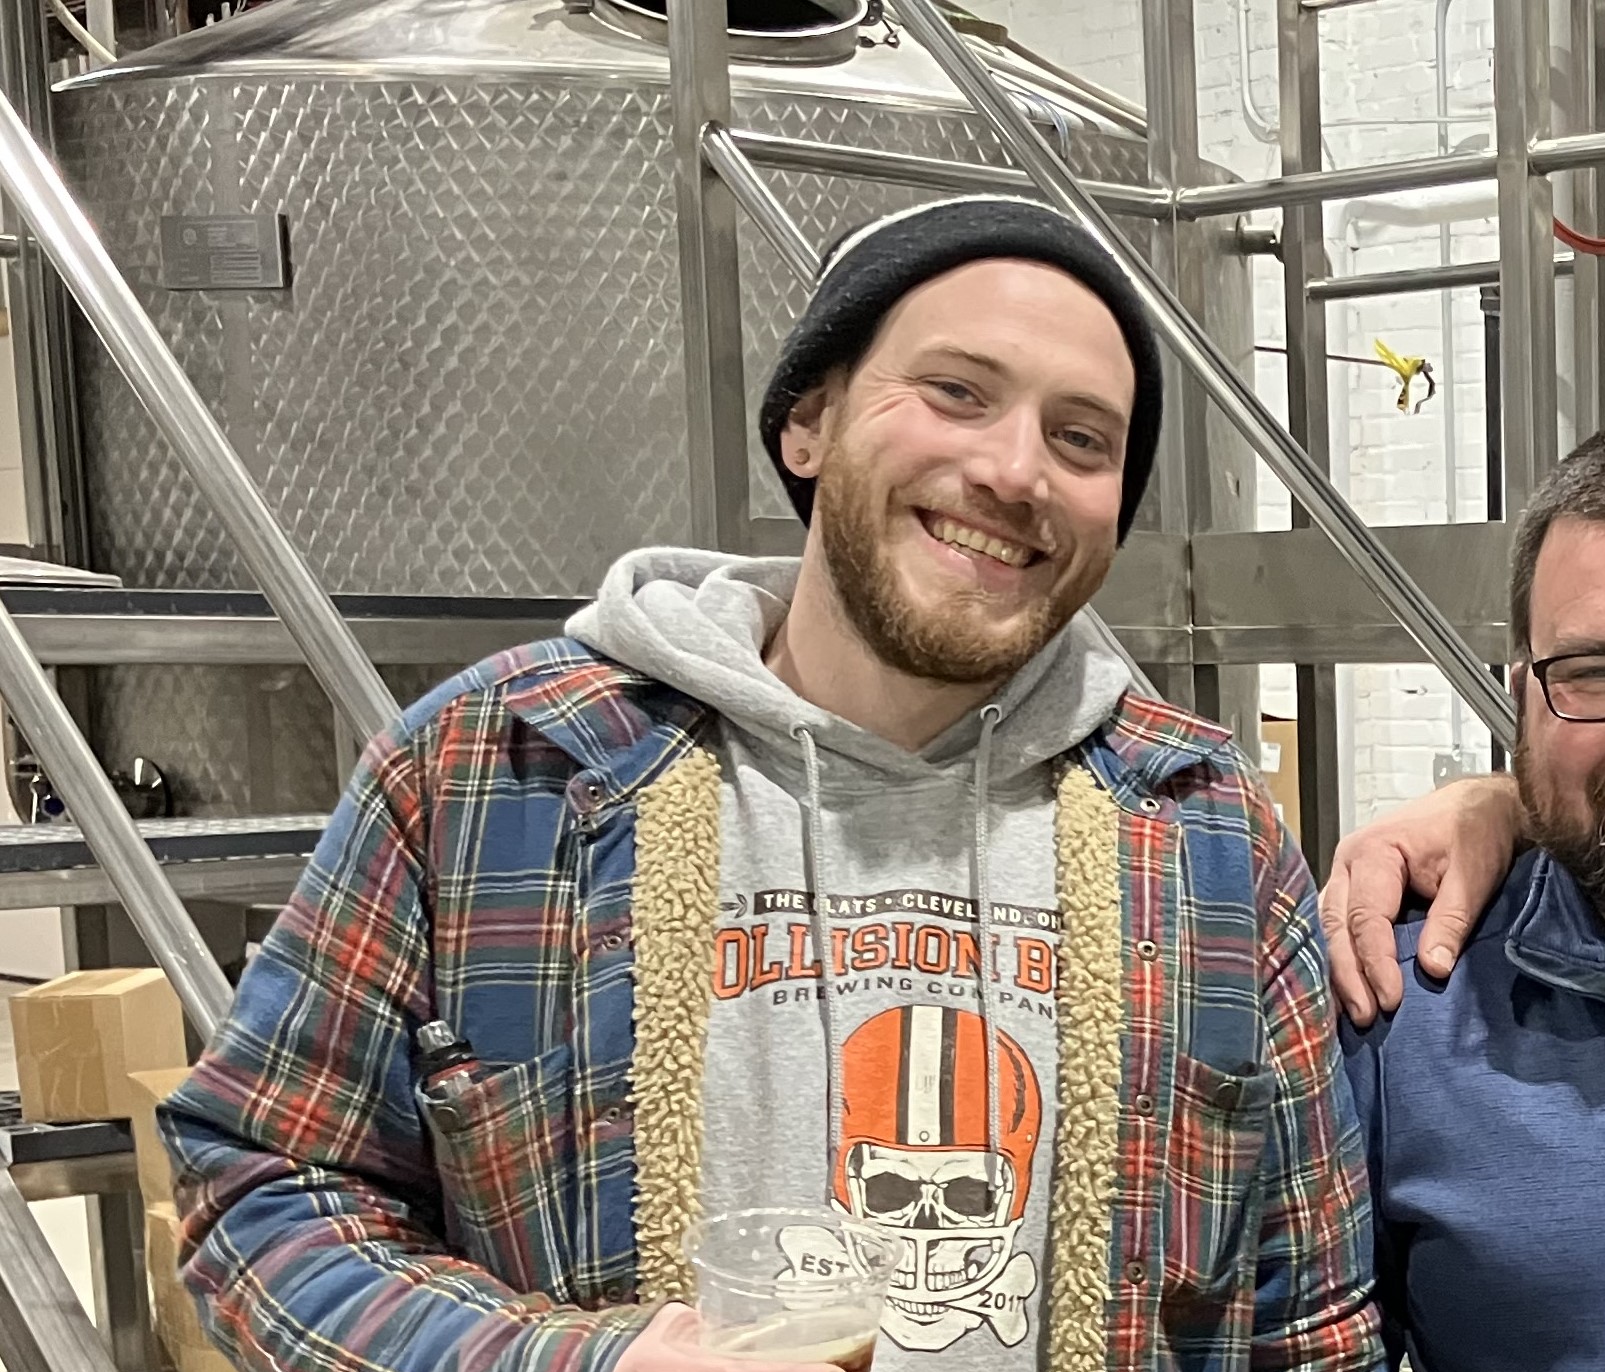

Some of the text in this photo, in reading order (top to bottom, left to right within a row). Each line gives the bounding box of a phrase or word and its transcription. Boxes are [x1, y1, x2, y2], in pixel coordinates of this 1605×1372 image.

[763, 893, 804, 909] THE
[825, 898, 877, 914] LATS
[1037, 912, 1063, 930] OH
[712, 920, 1000, 1000] OLLISION
